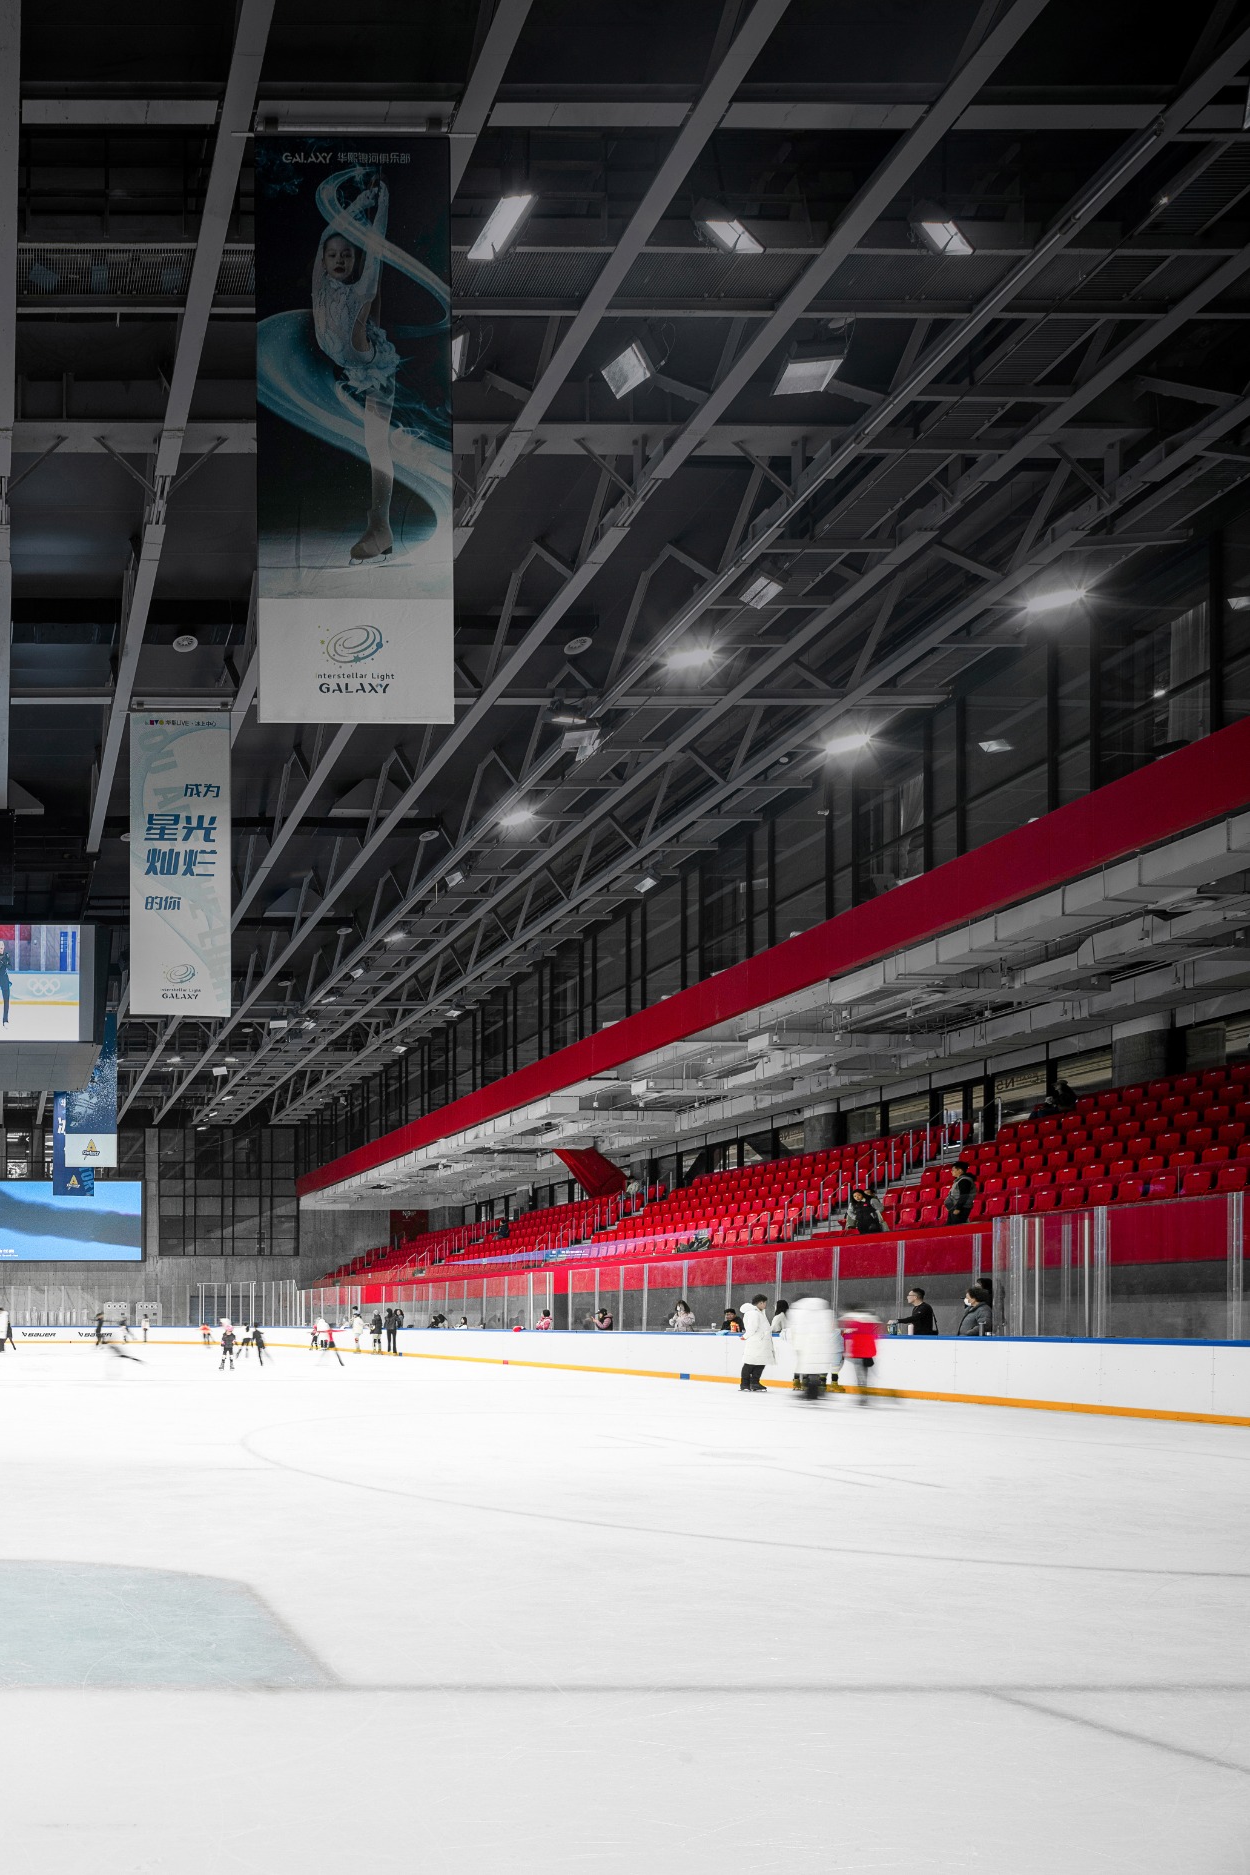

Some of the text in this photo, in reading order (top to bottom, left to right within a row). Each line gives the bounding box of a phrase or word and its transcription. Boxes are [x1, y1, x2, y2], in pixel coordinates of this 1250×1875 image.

[282, 152, 333, 164] GALAXY
[371, 672, 395, 682] Light
[318, 682, 390, 694] GALAXY
[183, 783, 221, 798] 成为
[144, 813, 218, 842] 星光
[144, 848, 218, 877] 灿烂
[144, 896, 182, 911] 的你
